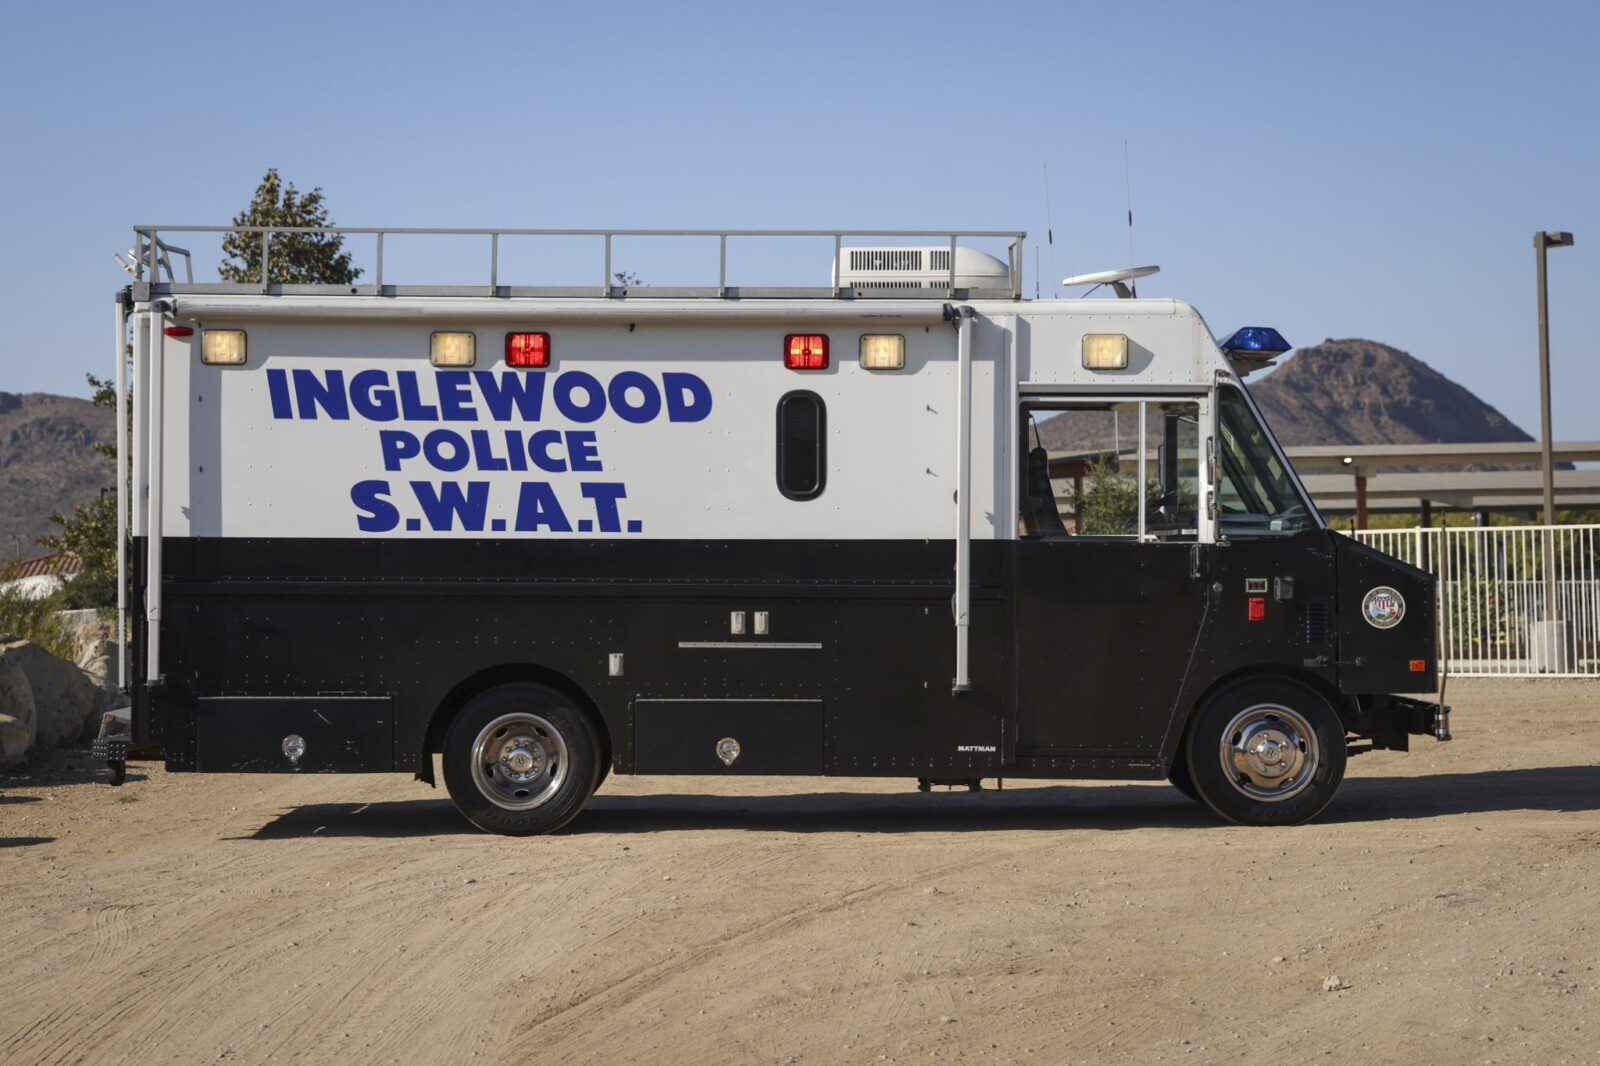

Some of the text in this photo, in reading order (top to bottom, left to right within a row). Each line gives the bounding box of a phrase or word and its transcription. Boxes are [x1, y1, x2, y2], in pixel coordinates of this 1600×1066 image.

[266, 369, 712, 423] INGLEWOOD
[379, 429, 603, 472] POLICE
[350, 480, 643, 532] S.W.A.T.
